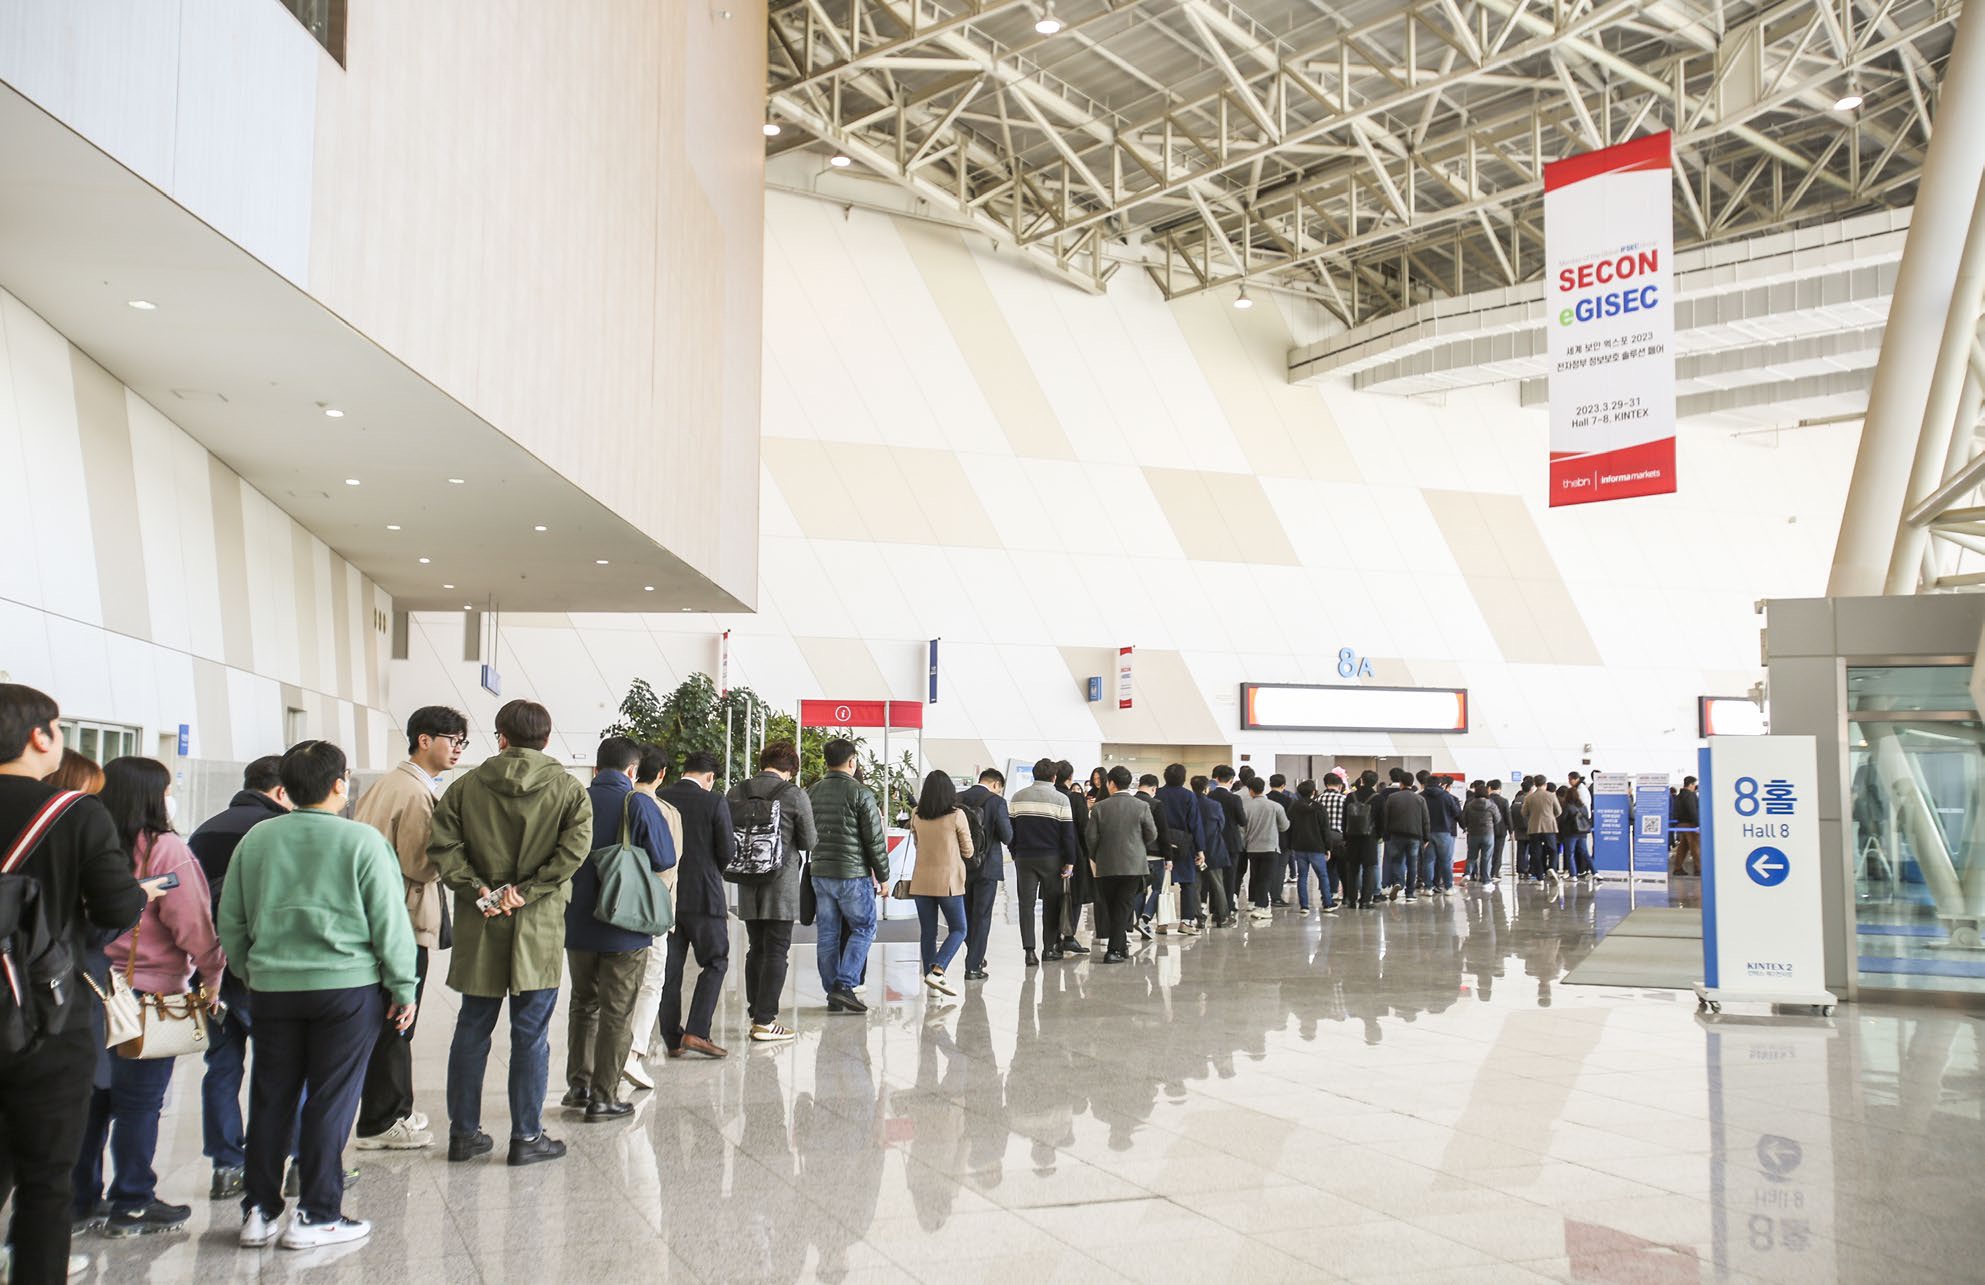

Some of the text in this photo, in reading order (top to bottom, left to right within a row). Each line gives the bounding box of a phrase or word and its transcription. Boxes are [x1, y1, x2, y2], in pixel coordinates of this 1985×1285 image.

[1559, 249, 1658, 292] SECON
[1559, 285, 1659, 327] eGISEC
[1631, 331, 1653, 344] 2023
[1576, 397, 1641, 415] 2023.3.29-31
[1571, 418, 1589, 428] Hall
[1614, 408, 1649, 422] KINTEX
[1338, 647, 1375, 678] 8A
[1734, 776, 1798, 817] 8홀
[1742, 823, 1790, 838] Hall 8
[1786, 963, 1793, 971] 2
